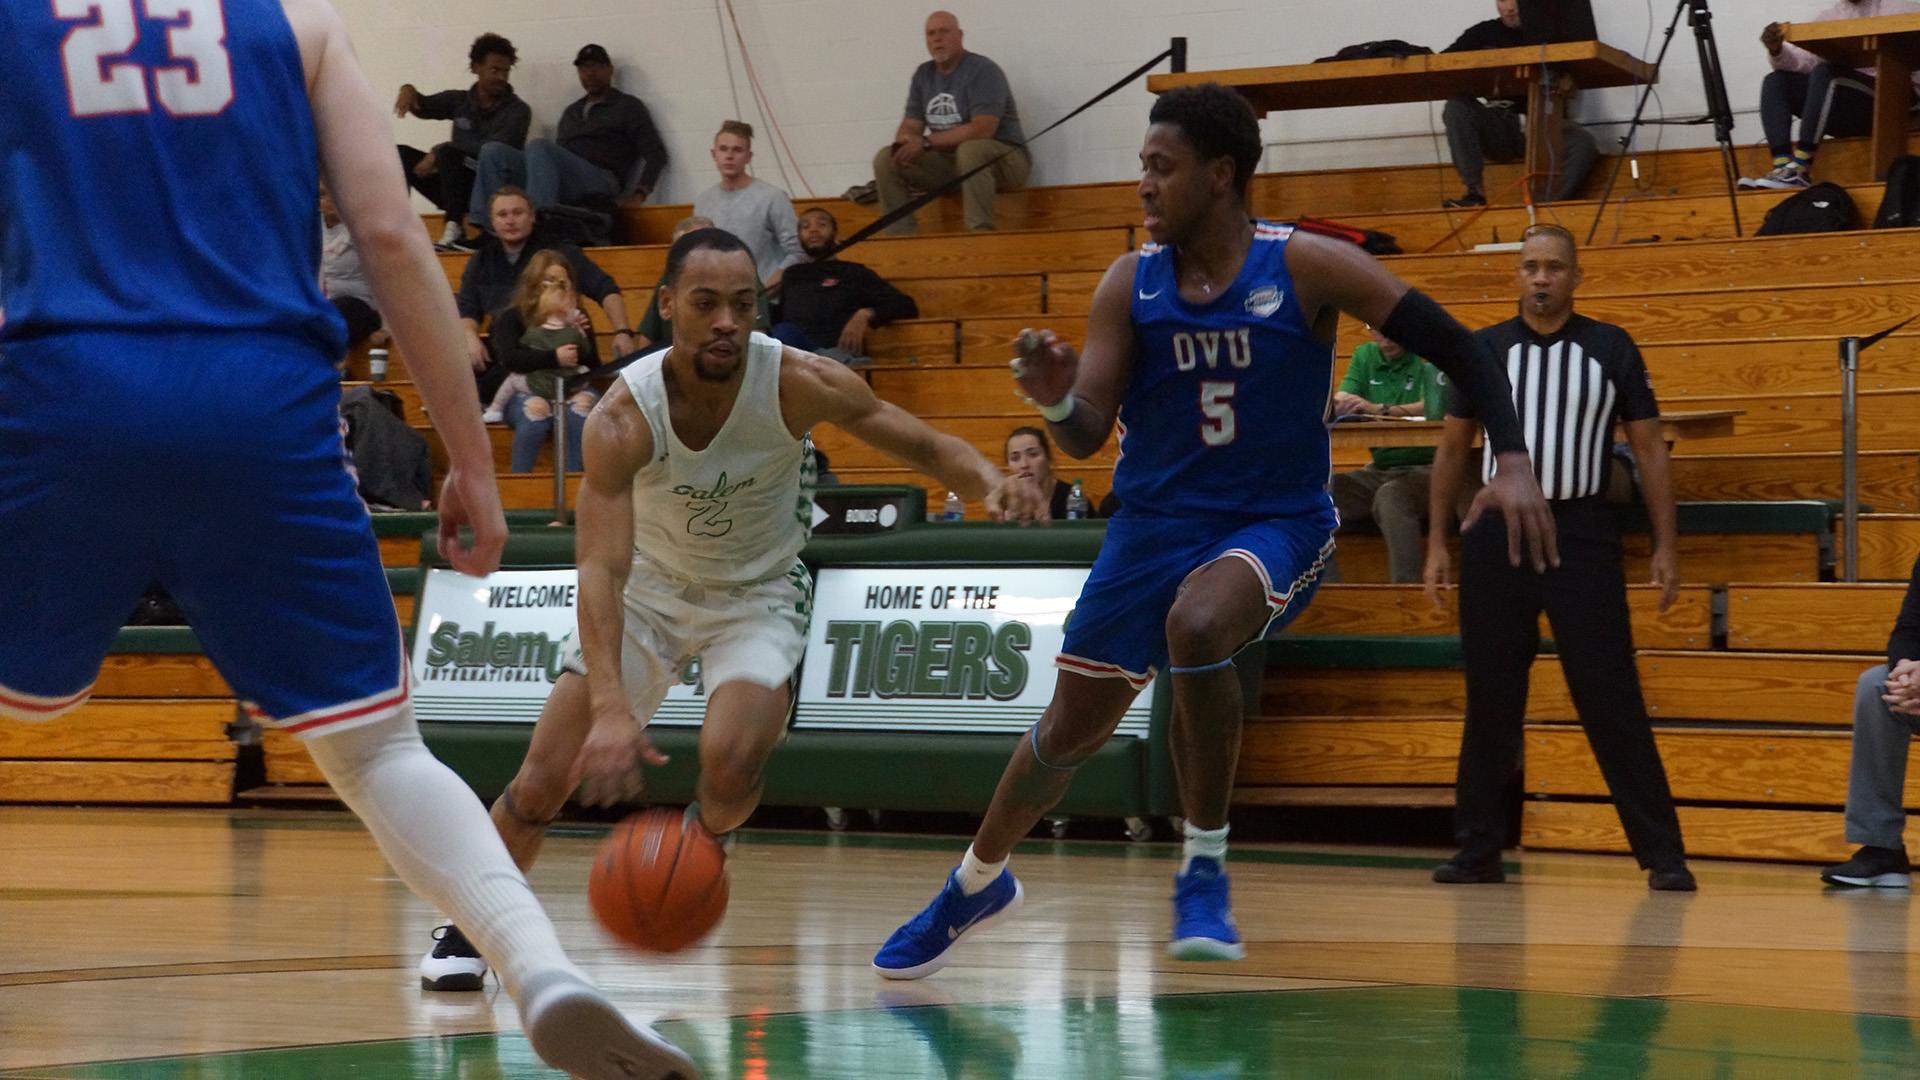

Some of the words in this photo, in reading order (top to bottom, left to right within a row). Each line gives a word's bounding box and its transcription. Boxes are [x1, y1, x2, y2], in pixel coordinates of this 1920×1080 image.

[50, 0, 236, 119] 23
[1173, 327, 1252, 372] OVU
[1200, 380, 1236, 447] 5
[667, 471, 757, 499] Salem
[686, 500, 733, 537] 2
[845, 508, 878, 523] BONUS
[488, 585, 575, 608] WELCOME
[865, 585, 924, 609] HOME
[930, 585, 957, 609] OF
[961, 586, 1000, 609] THE
[426, 621, 549, 668] Salem
[825, 619, 1032, 701] TIGERS
[423, 667, 541, 682] INTERNATIONAL
